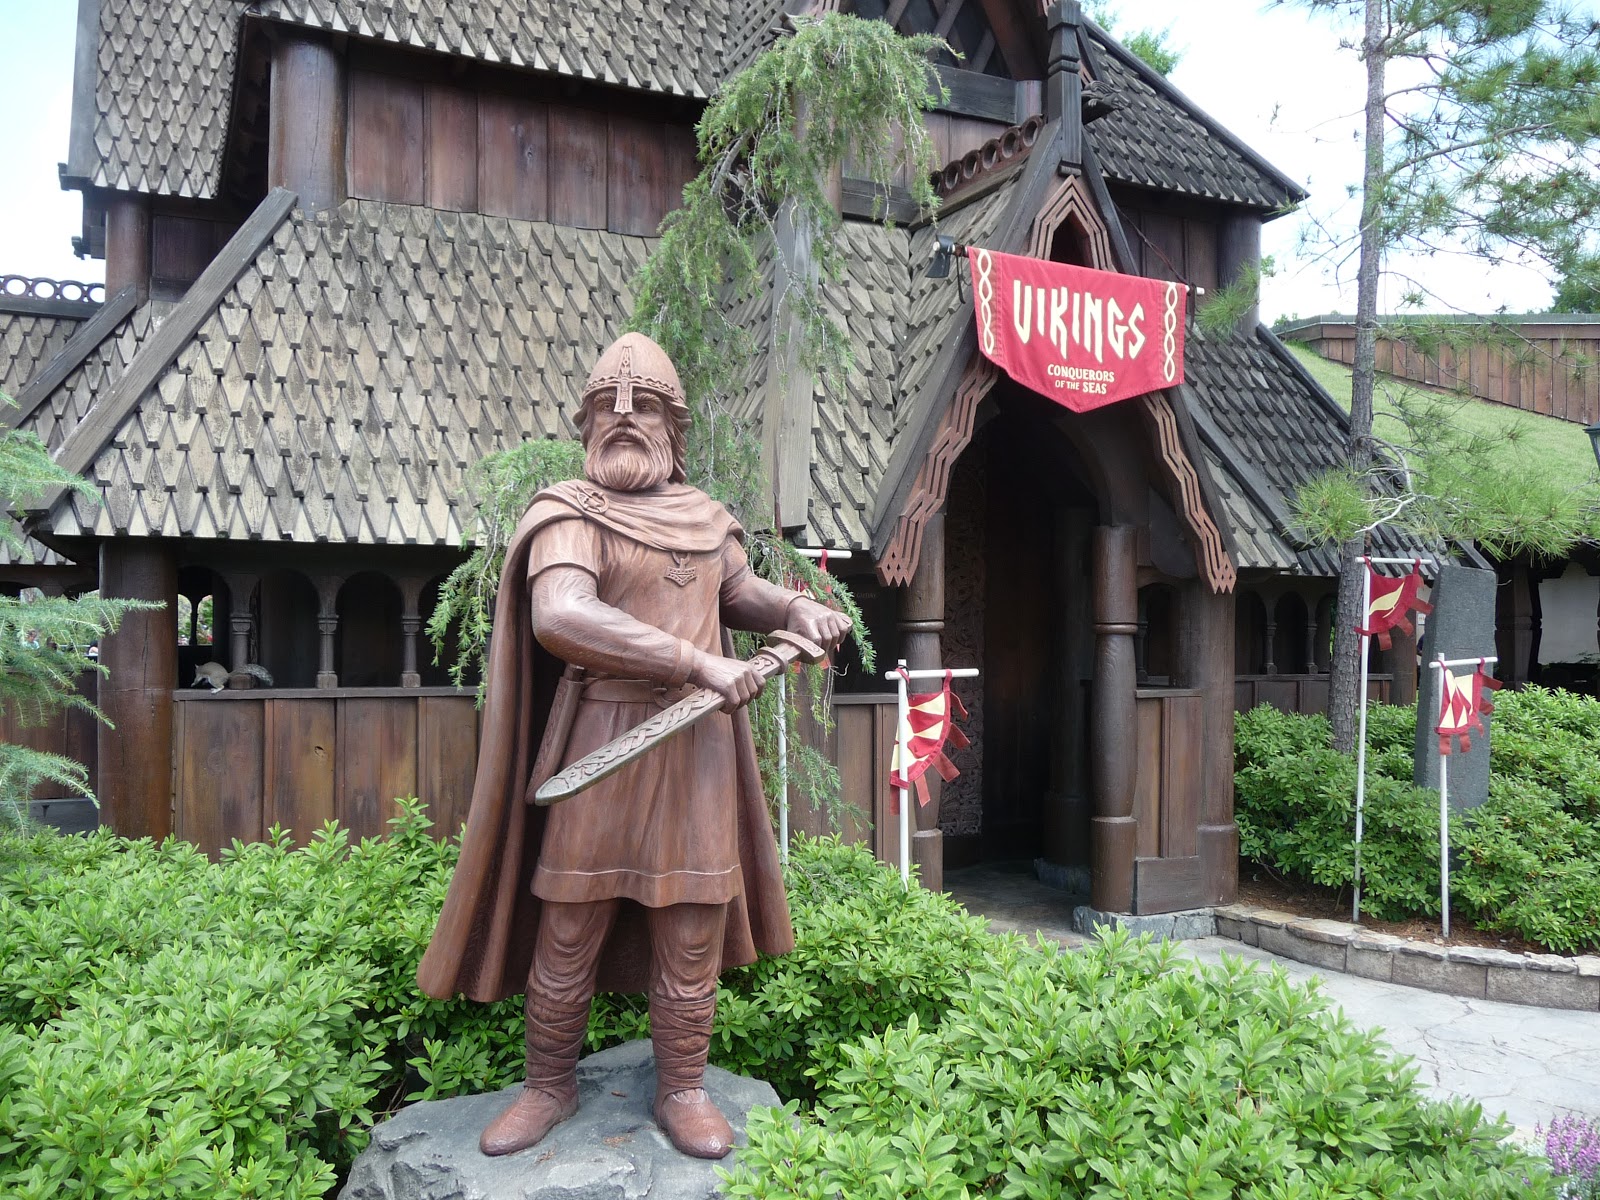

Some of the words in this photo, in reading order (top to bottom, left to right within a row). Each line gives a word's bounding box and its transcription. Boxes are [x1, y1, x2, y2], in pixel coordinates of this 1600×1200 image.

[1013, 279, 1146, 363] VIKINGS
[1047, 363, 1115, 383] CONQUERORS
[1055, 379, 1065, 388] OF
[1066, 381, 1080, 390] THE
[1082, 381, 1107, 395] SEAS
